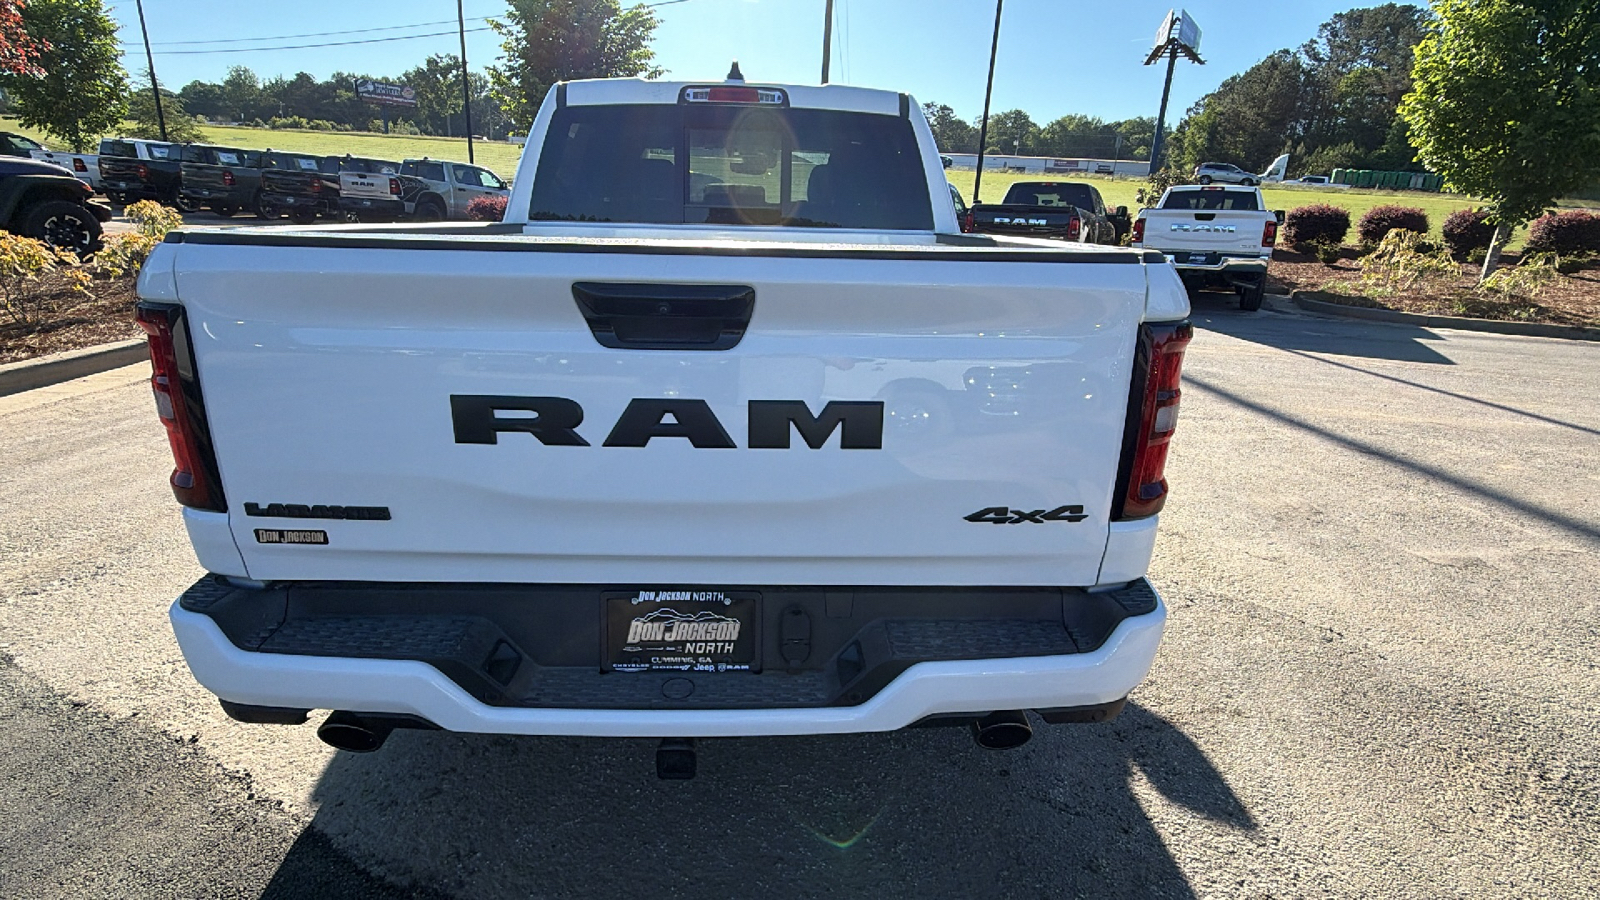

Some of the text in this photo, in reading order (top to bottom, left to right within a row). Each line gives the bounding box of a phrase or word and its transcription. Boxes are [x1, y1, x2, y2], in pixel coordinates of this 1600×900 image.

[993, 217, 1047, 226] RAM
[1170, 223, 1237, 233] RAM
[449, 394, 885, 450] RAM
[962, 504, 1089, 525] 4x4
[281, 530, 325, 543] JACKSON
[656, 591, 692, 602] JACKSON
[692, 592, 725, 602] NORTH
[664, 621, 742, 643] JACKSON
[684, 642, 734, 654] NORTH
[693, 663, 715, 672] Jeep
